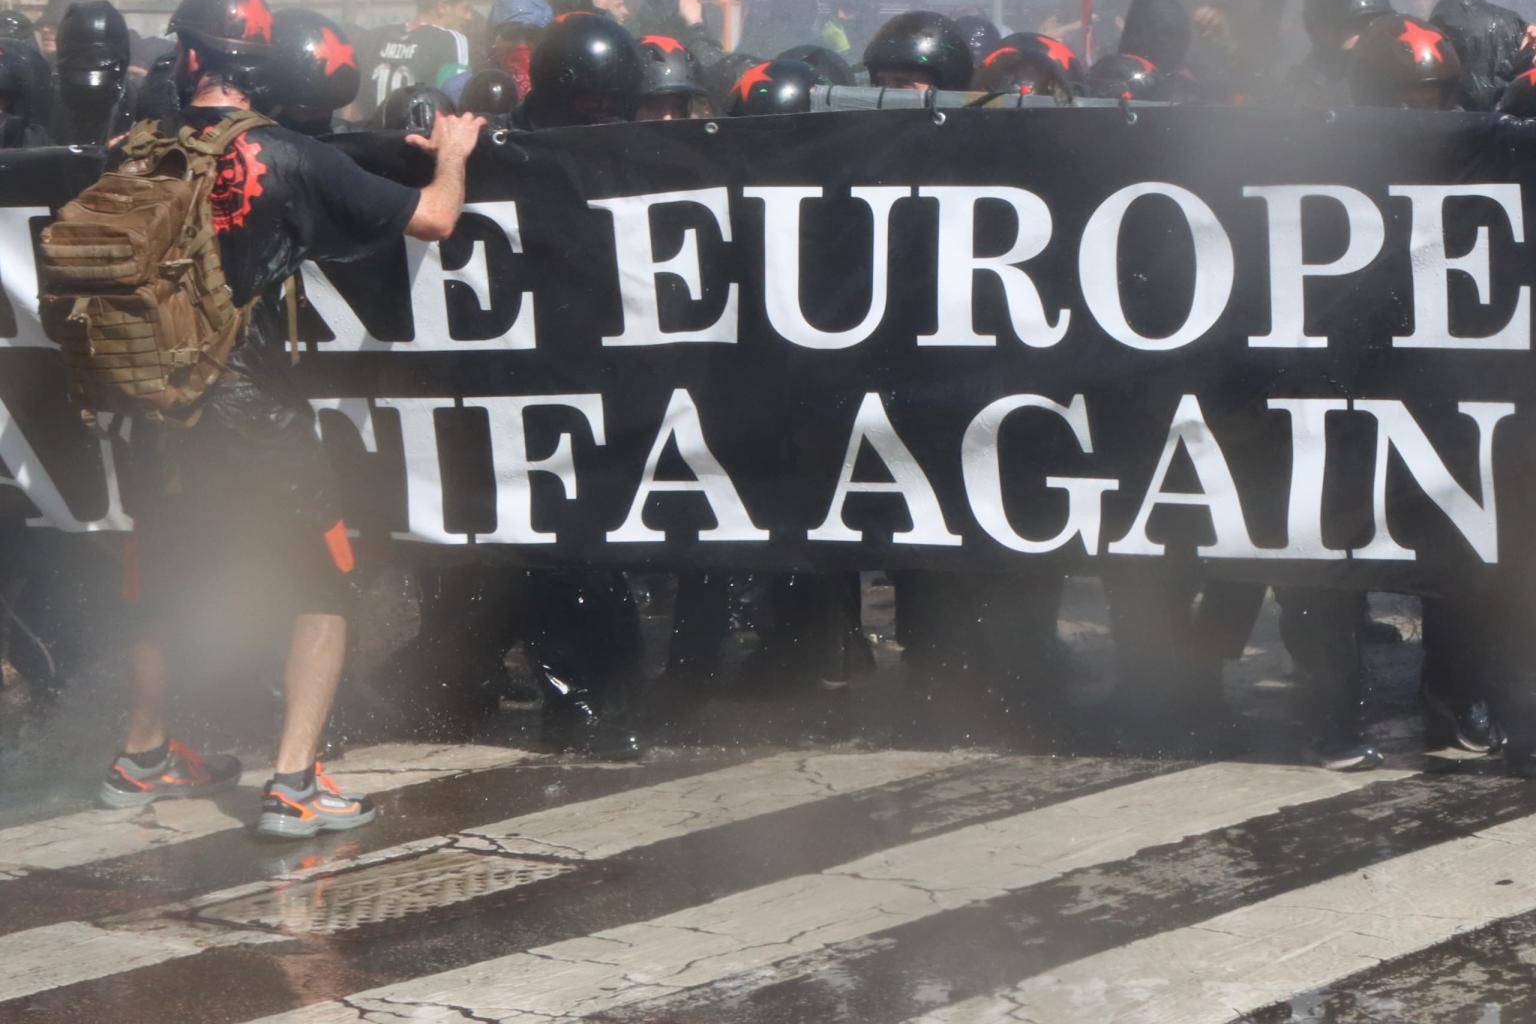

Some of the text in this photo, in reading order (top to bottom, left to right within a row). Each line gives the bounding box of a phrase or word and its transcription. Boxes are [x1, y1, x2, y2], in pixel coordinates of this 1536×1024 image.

[587, 181, 1531, 352] EUROPE
[0, 387, 1516, 564] AIFA AGAIN
